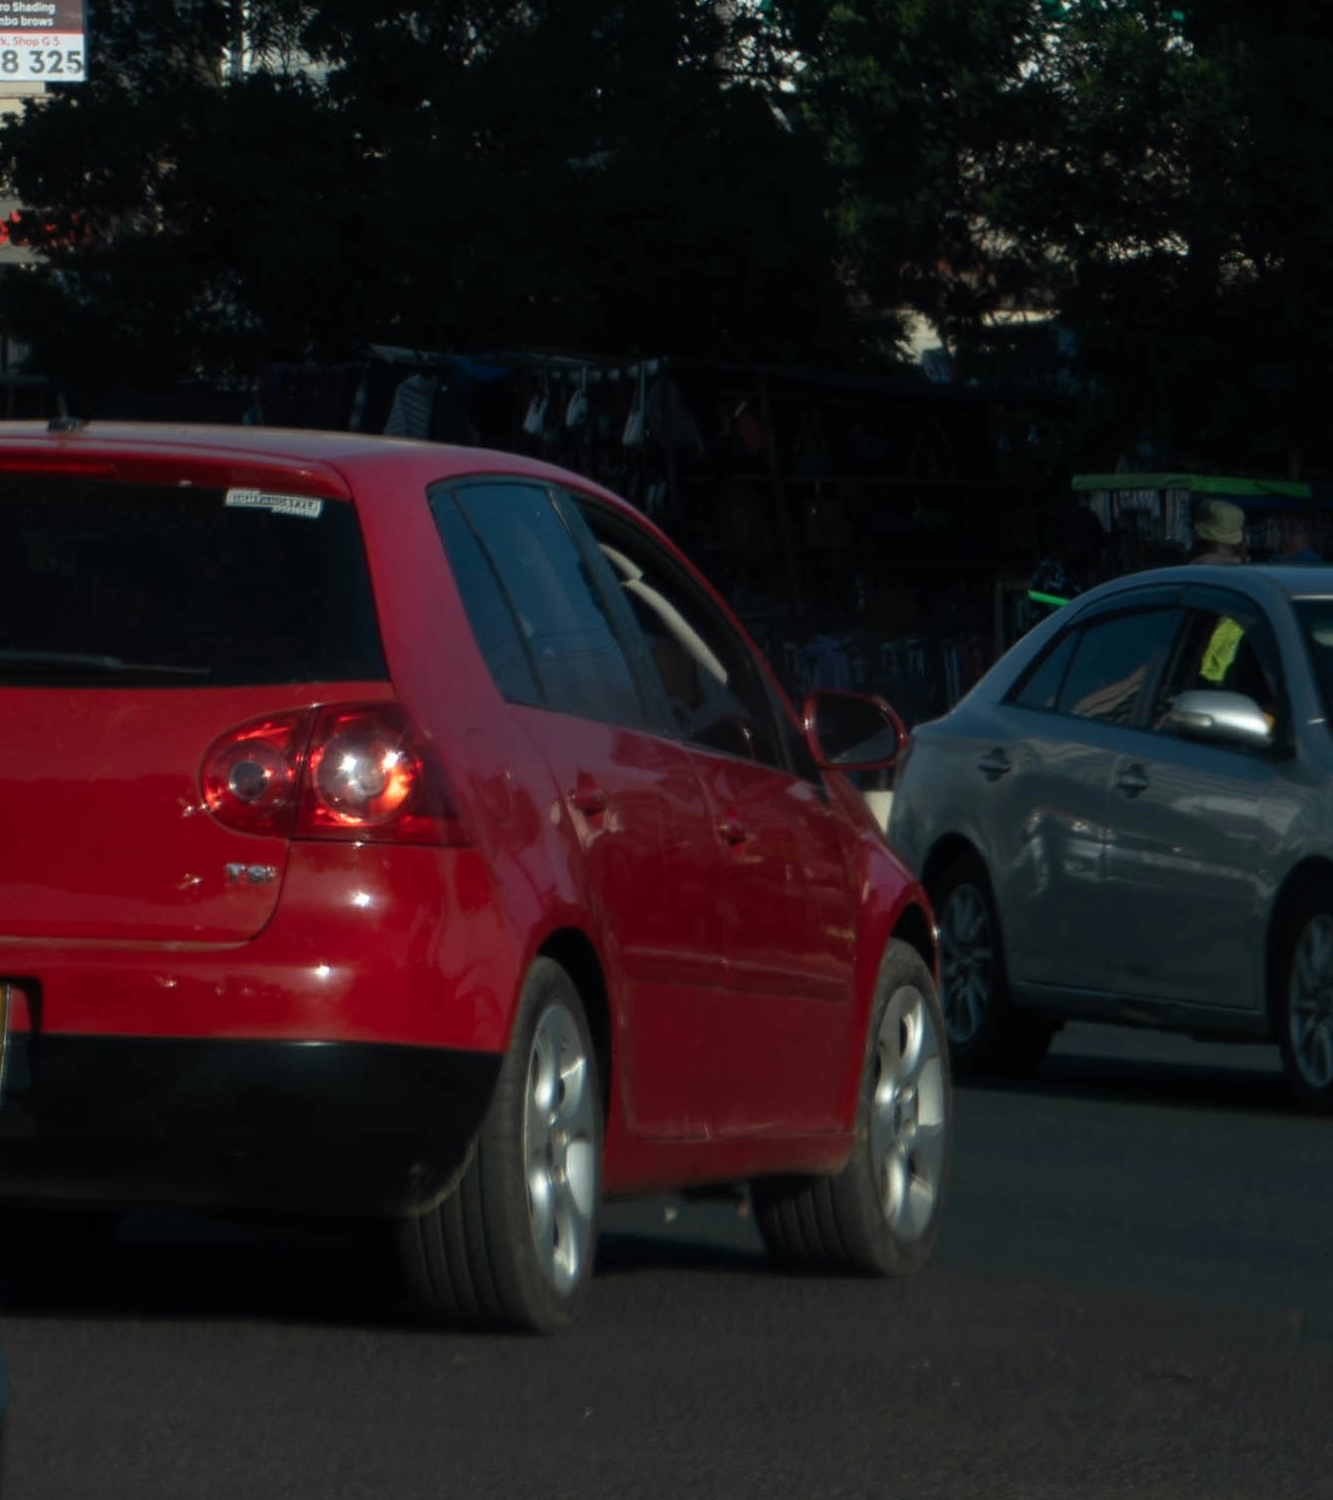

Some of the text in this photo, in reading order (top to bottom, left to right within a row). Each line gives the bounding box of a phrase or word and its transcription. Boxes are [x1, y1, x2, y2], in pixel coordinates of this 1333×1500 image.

[12, 1, 56, 15] Shading
[20, 15, 53, 26] brows
[12, 35, 39, 47] Shop
[28, 50, 83, 74] 325
